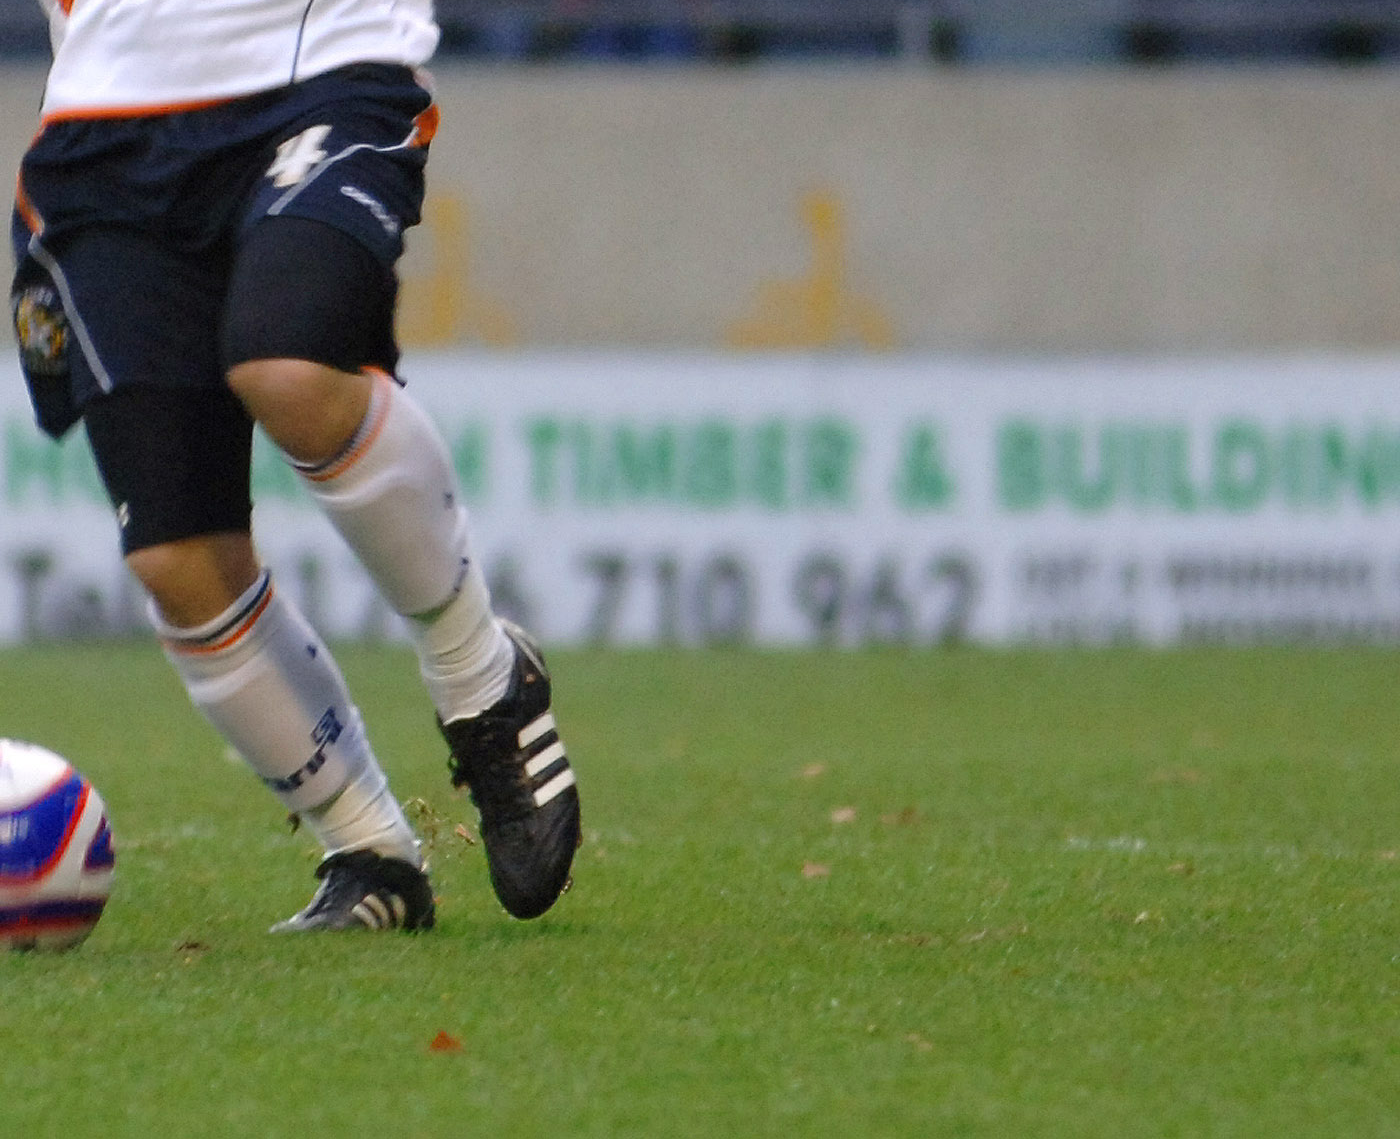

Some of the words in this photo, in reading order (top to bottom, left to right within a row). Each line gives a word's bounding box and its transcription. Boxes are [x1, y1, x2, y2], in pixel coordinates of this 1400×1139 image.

[265, 124, 333, 188] 4
[524, 416, 860, 511] TIMBER
[895, 416, 956, 511] &
[572, 547, 756, 647] 710
[790, 546, 984, 646] 962
